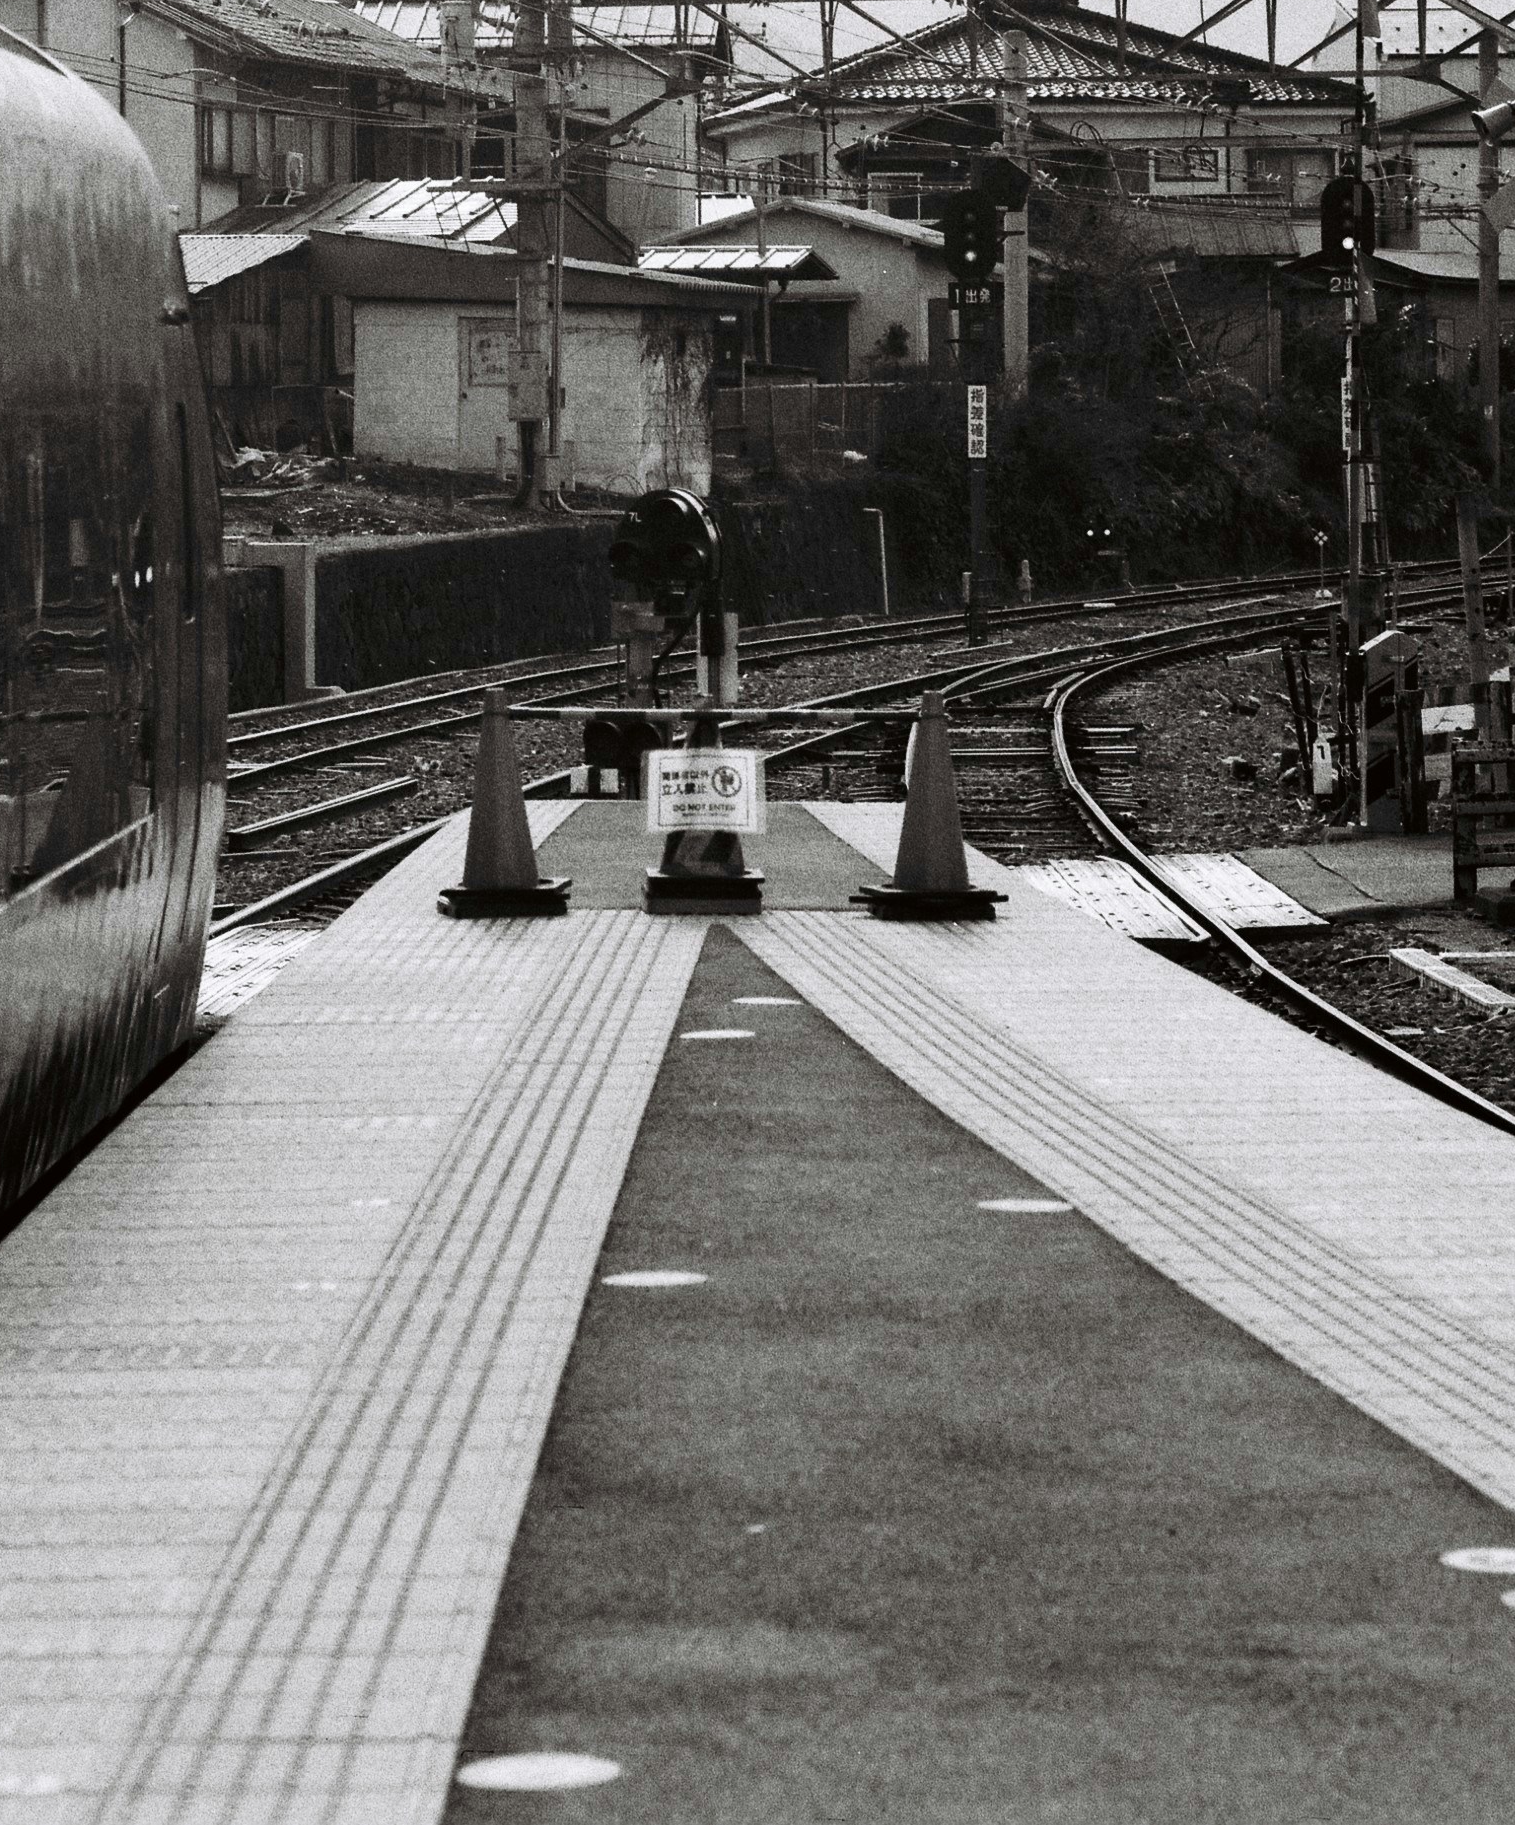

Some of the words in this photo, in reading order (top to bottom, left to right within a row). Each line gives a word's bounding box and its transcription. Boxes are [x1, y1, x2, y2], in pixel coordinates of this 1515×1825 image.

[970, 388, 984, 455] 指差確認
[628, 512, 642, 522] 7L
[672, 803, 686, 812] DO
[687, 803, 706, 811] NOT
[708, 803, 736, 811] ENTER
